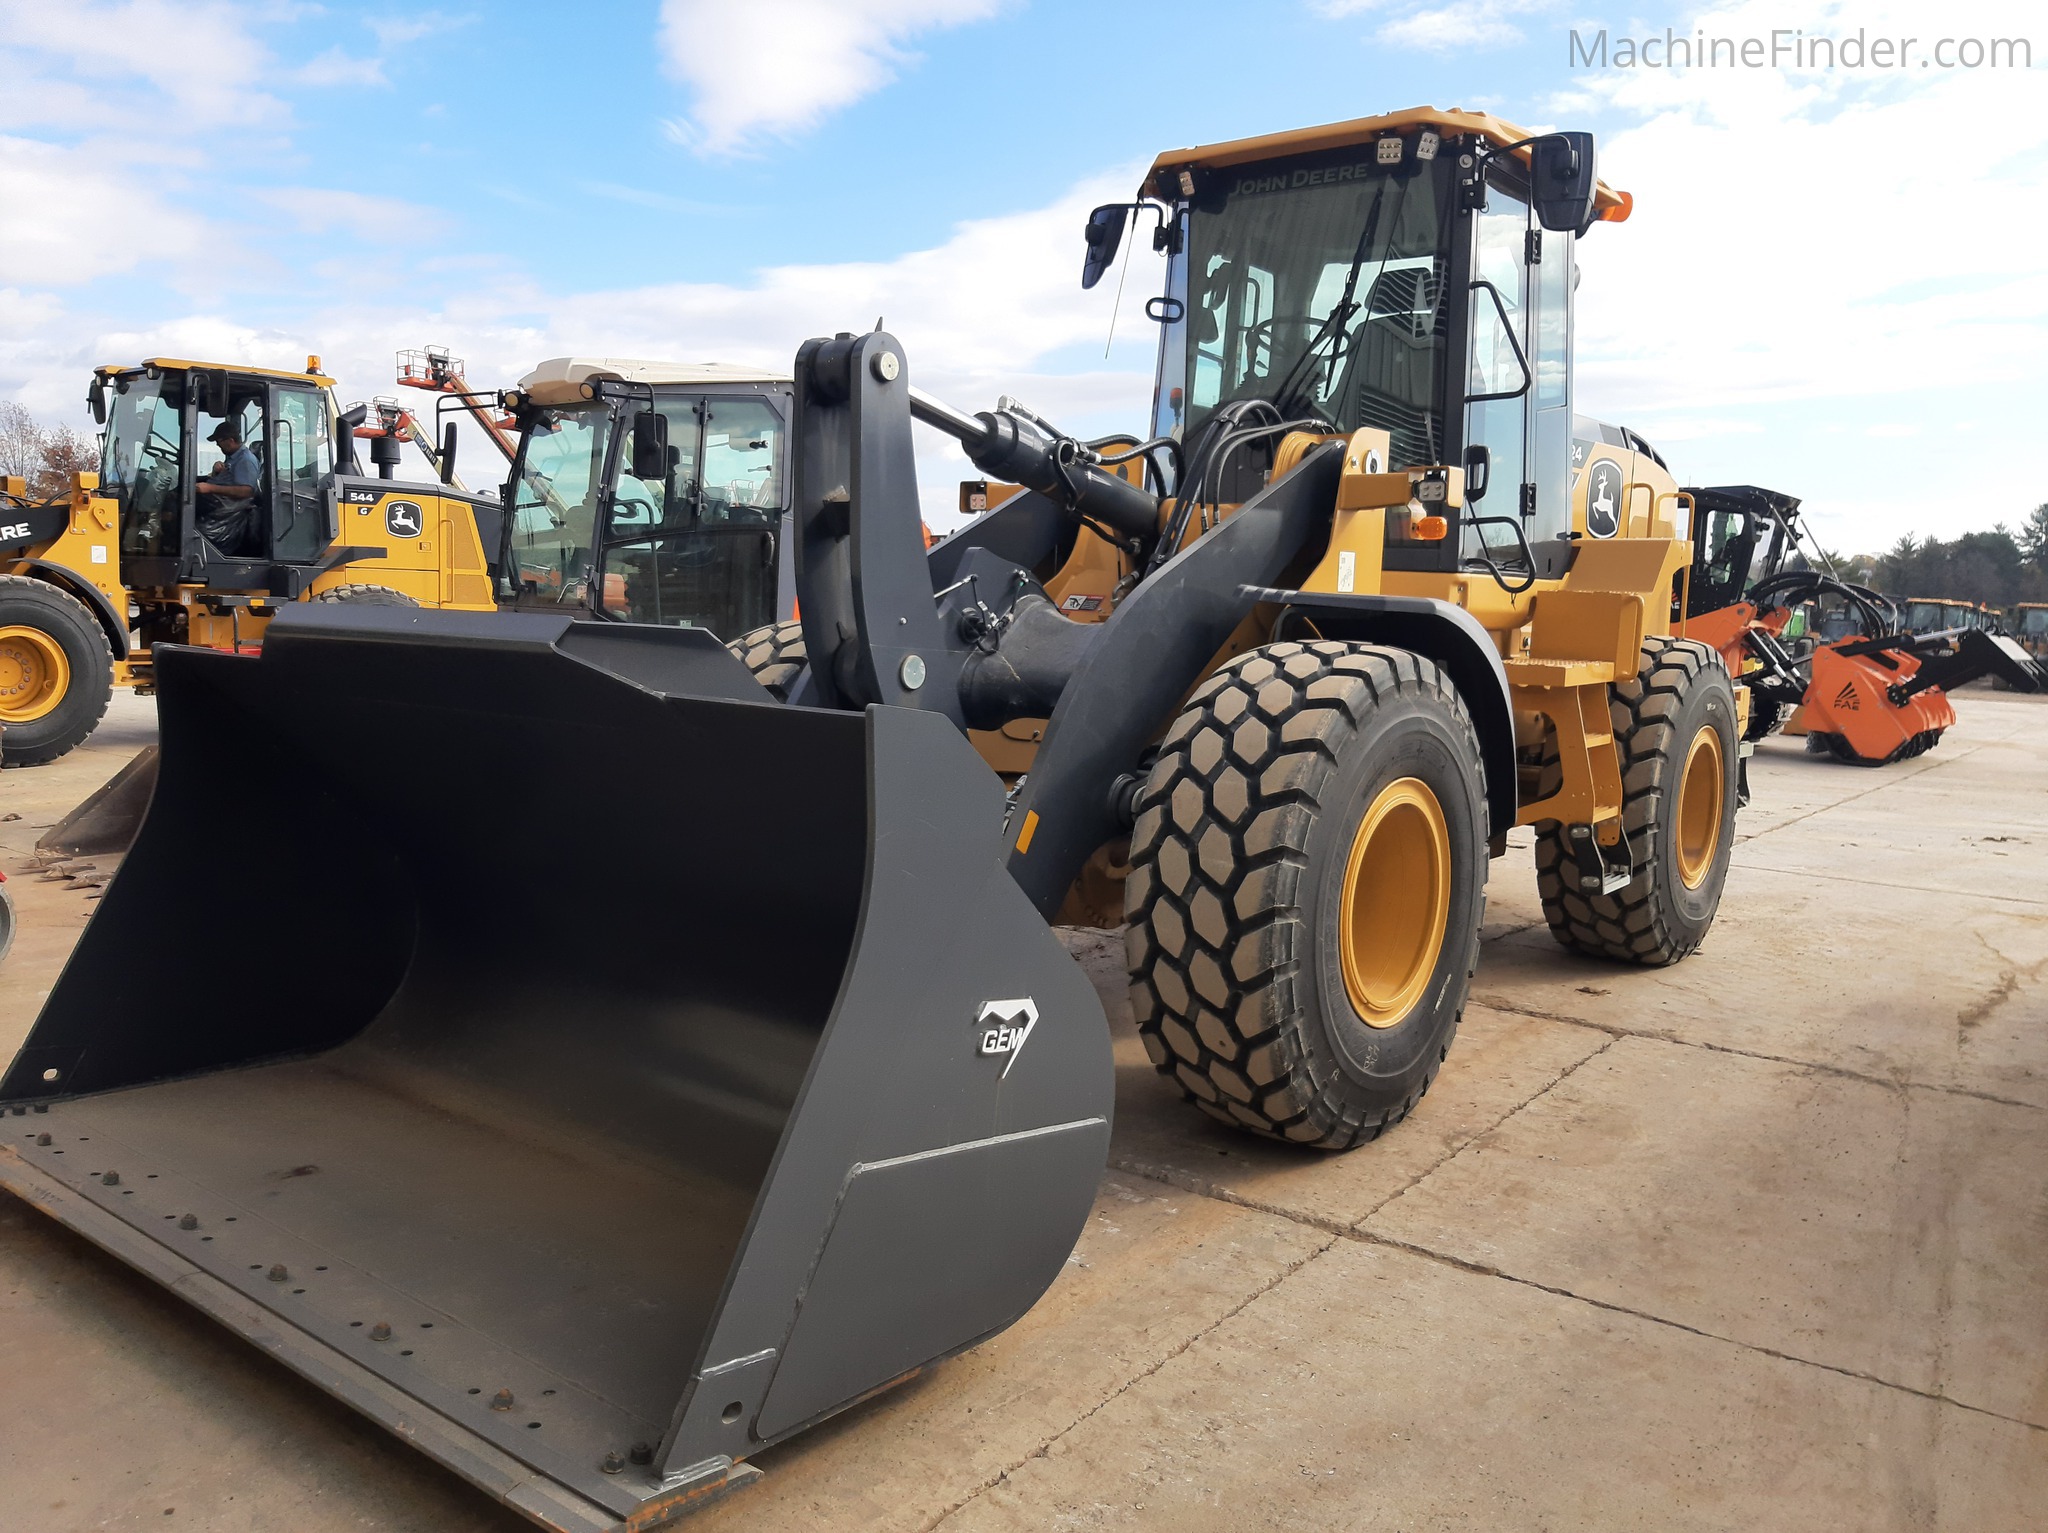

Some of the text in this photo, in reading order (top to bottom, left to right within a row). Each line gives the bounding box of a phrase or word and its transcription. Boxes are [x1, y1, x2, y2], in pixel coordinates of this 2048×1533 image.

[1232, 162, 1369, 196] JOHN DEERE
[350, 492, 375, 502] 544
[360, 507, 368, 515] G
[0, 522, 32, 541] RE
[1833, 699, 1861, 711] FAE
[982, 1026, 1025, 1054] GEM
